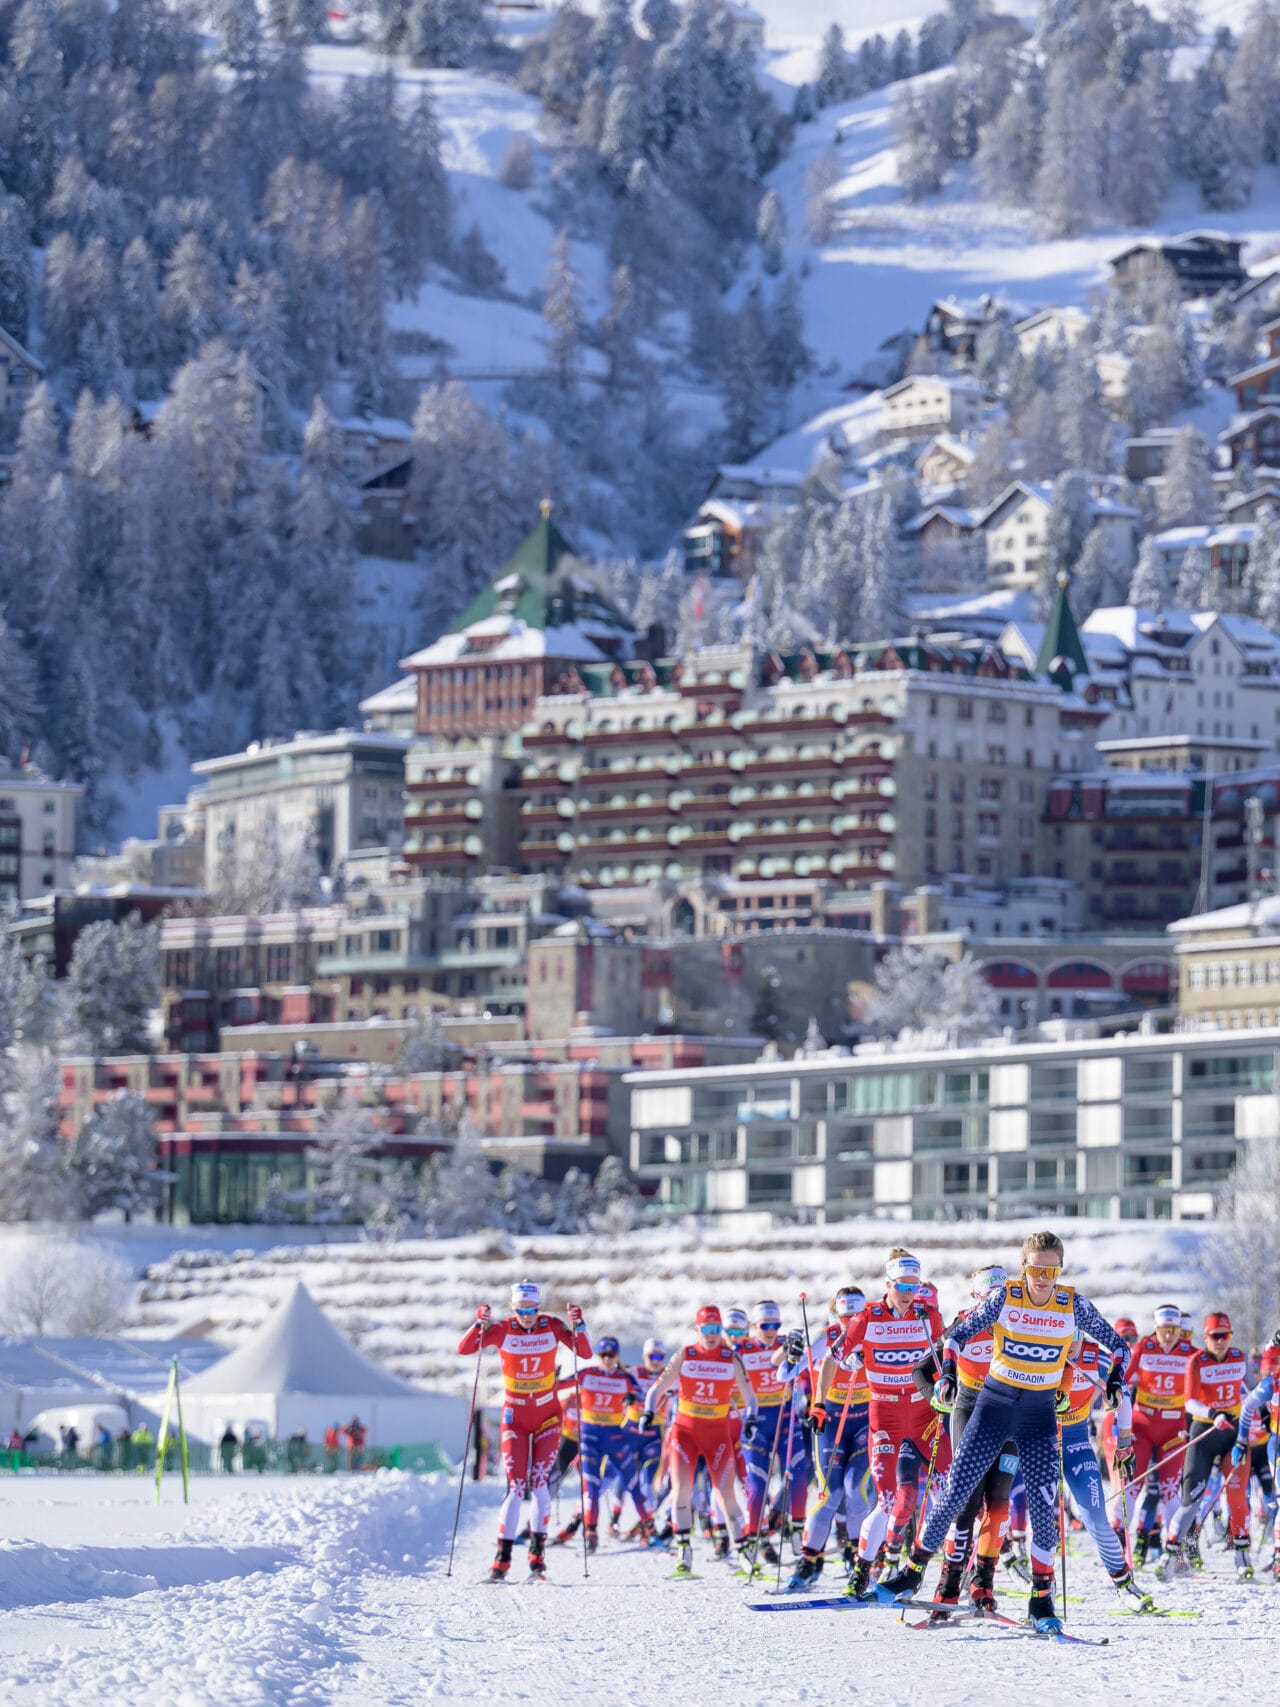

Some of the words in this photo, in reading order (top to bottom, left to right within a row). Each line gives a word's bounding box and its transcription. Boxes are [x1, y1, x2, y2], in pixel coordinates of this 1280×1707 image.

[1022, 1313, 1065, 1328] Sunrise
[887, 1325, 923, 1334] Sunrise
[520, 1338, 549, 1347] Sunrise
[874, 1351, 923, 1362] coop
[1005, 1341, 1060, 1361] coop
[520, 1357, 541, 1372] 17
[697, 1365, 728, 1374] Sunrise
[1214, 1366, 1242, 1375] Sunrise
[883, 1375, 912, 1383] ENGADI
[1007, 1370, 1045, 1383] ENGADIN
[1154, 1375, 1175, 1389] 16
[695, 1382, 716, 1397] 21
[1216, 1384, 1235, 1400] 13
[594, 1392, 613, 1406] 37
